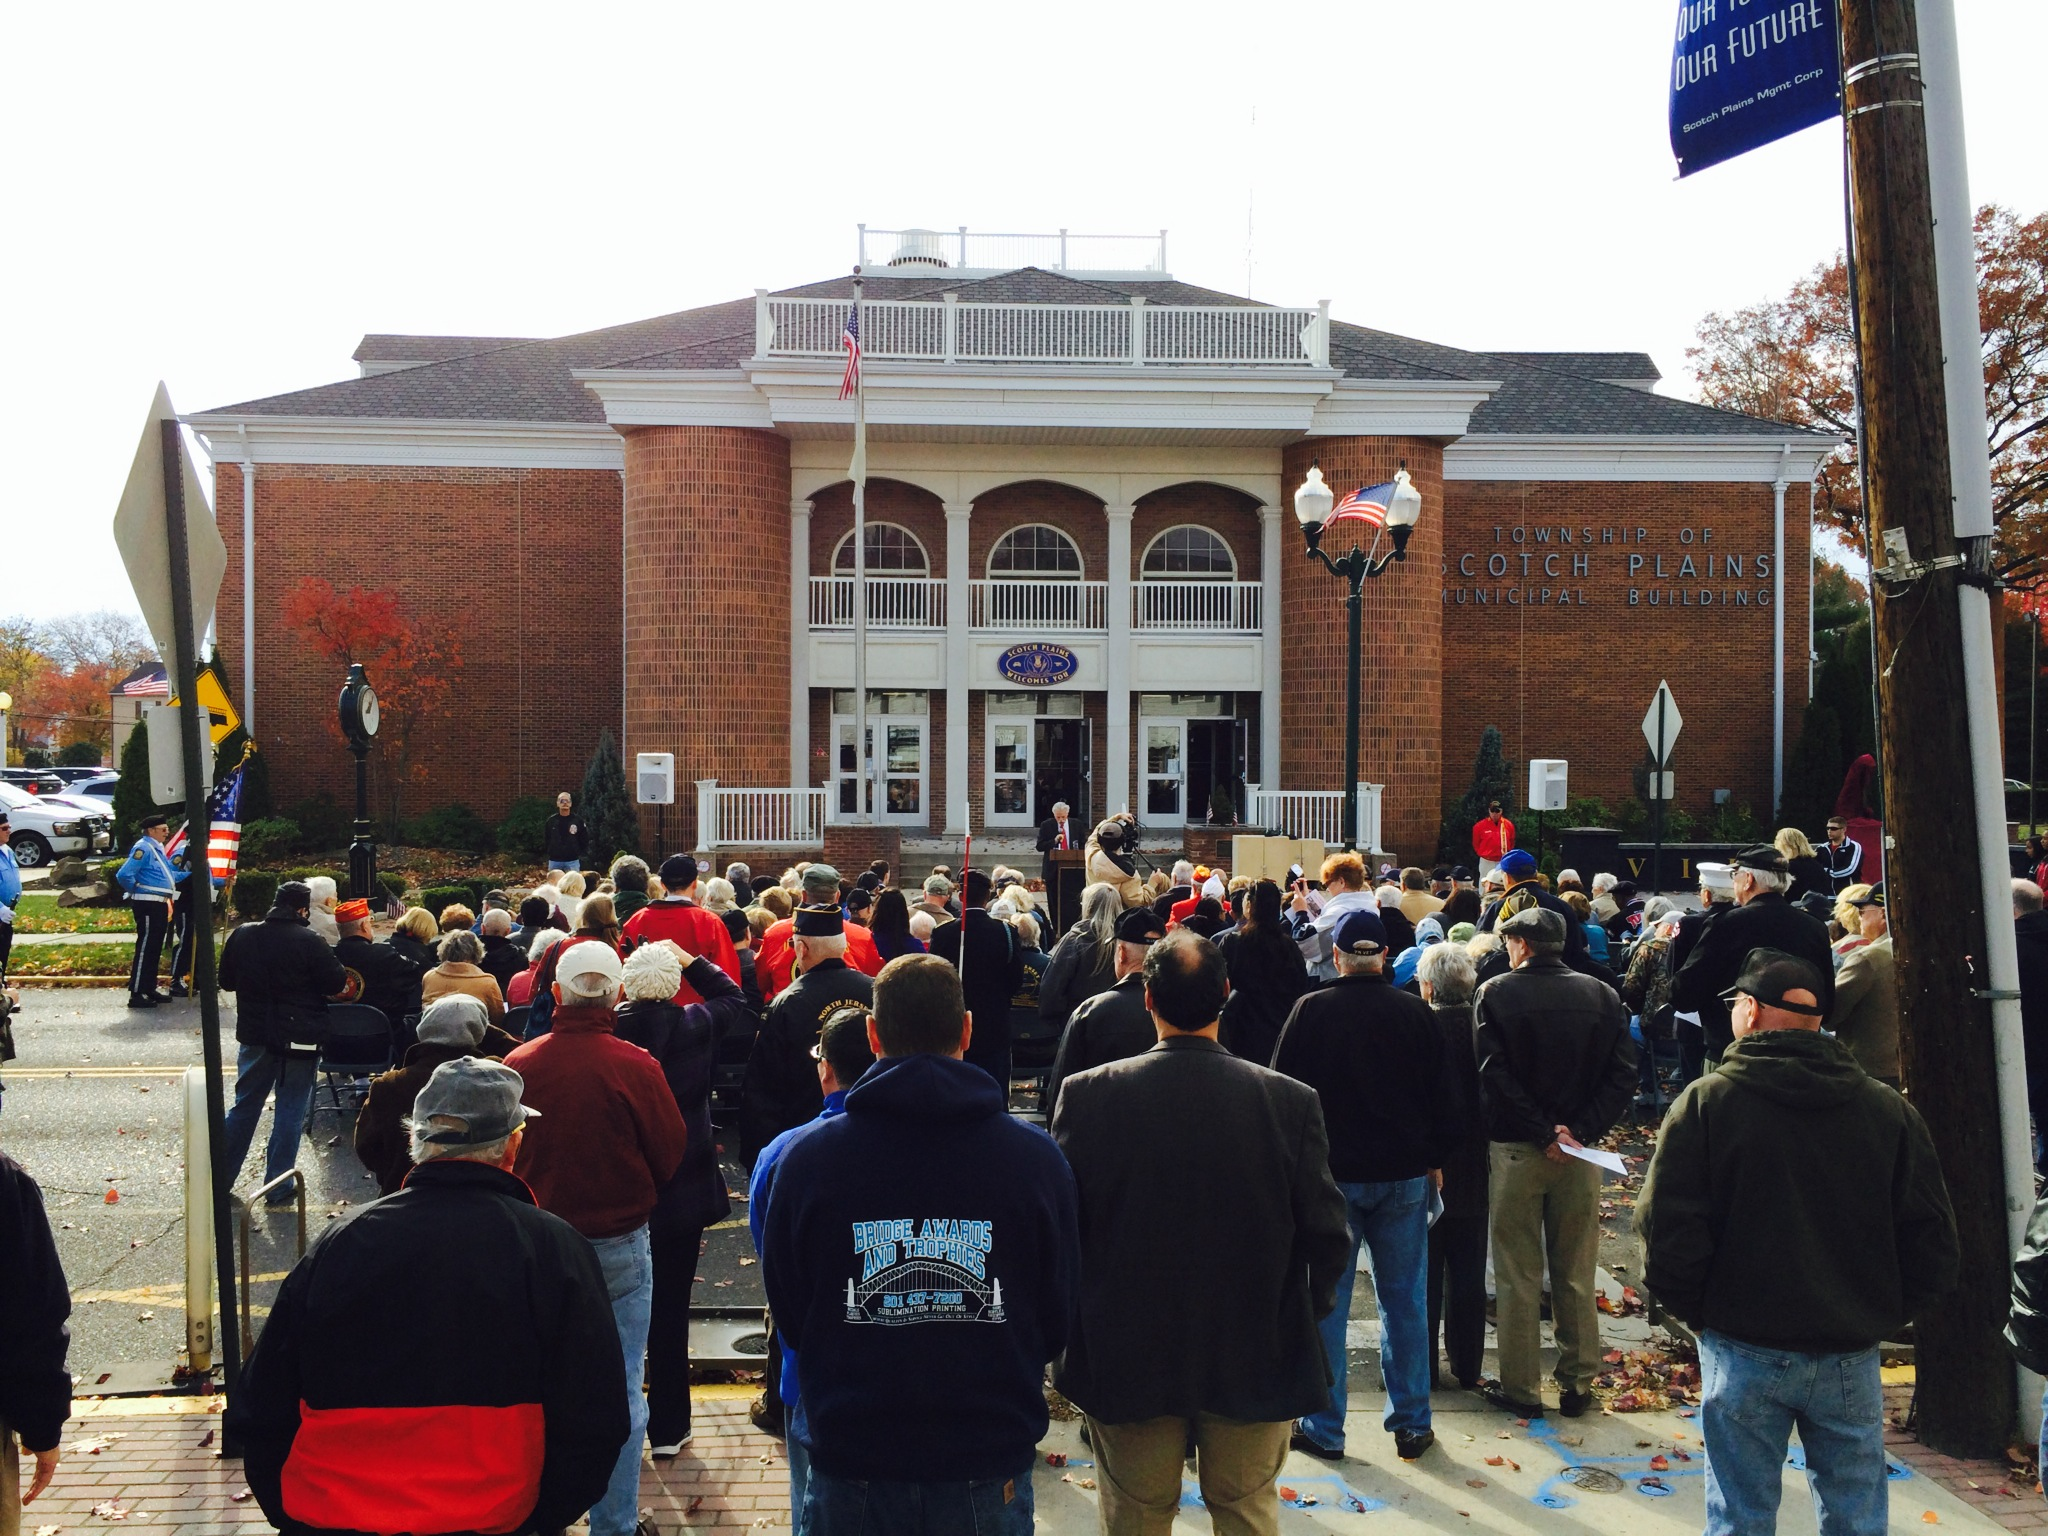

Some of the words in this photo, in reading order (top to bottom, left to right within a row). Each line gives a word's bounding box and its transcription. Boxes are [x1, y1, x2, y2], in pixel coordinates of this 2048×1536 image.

[1677, 0, 1716, 41] OUR
[1675, 44, 1718, 91] OUR
[1727, 0, 1824, 64] FUTURE
[1682, 112, 1719, 133] Scotch
[1721, 97, 1754, 116] Plains
[1757, 81, 1792, 101] Mgmt
[1794, 68, 1824, 85] Corp
[1494, 527, 1647, 544] TOWNSHIP
[1680, 528, 1712, 544] OF
[1629, 554, 1770, 578] PLAINS
[1629, 589, 1769, 605] BUILDING
[1007, 644, 1038, 657] SCOTCH
[1041, 644, 1069, 657] PLAINS
[1006, 671, 1049, 684] WELCOMES
[1053, 671, 1069, 682] YOU
[818, 999, 842, 1022] NORTH
[852, 1219, 914, 1254] BRIDGE
[920, 1218, 993, 1254] AWARDS
[862, 1242, 897, 1282] AND
[902, 1237, 986, 1281] TROPHIES
[877, 1304, 929, 1316] SUBLIMINATION
[931, 1304, 967, 1312] PRINTING
[883, 1295, 904, 1307] 201
